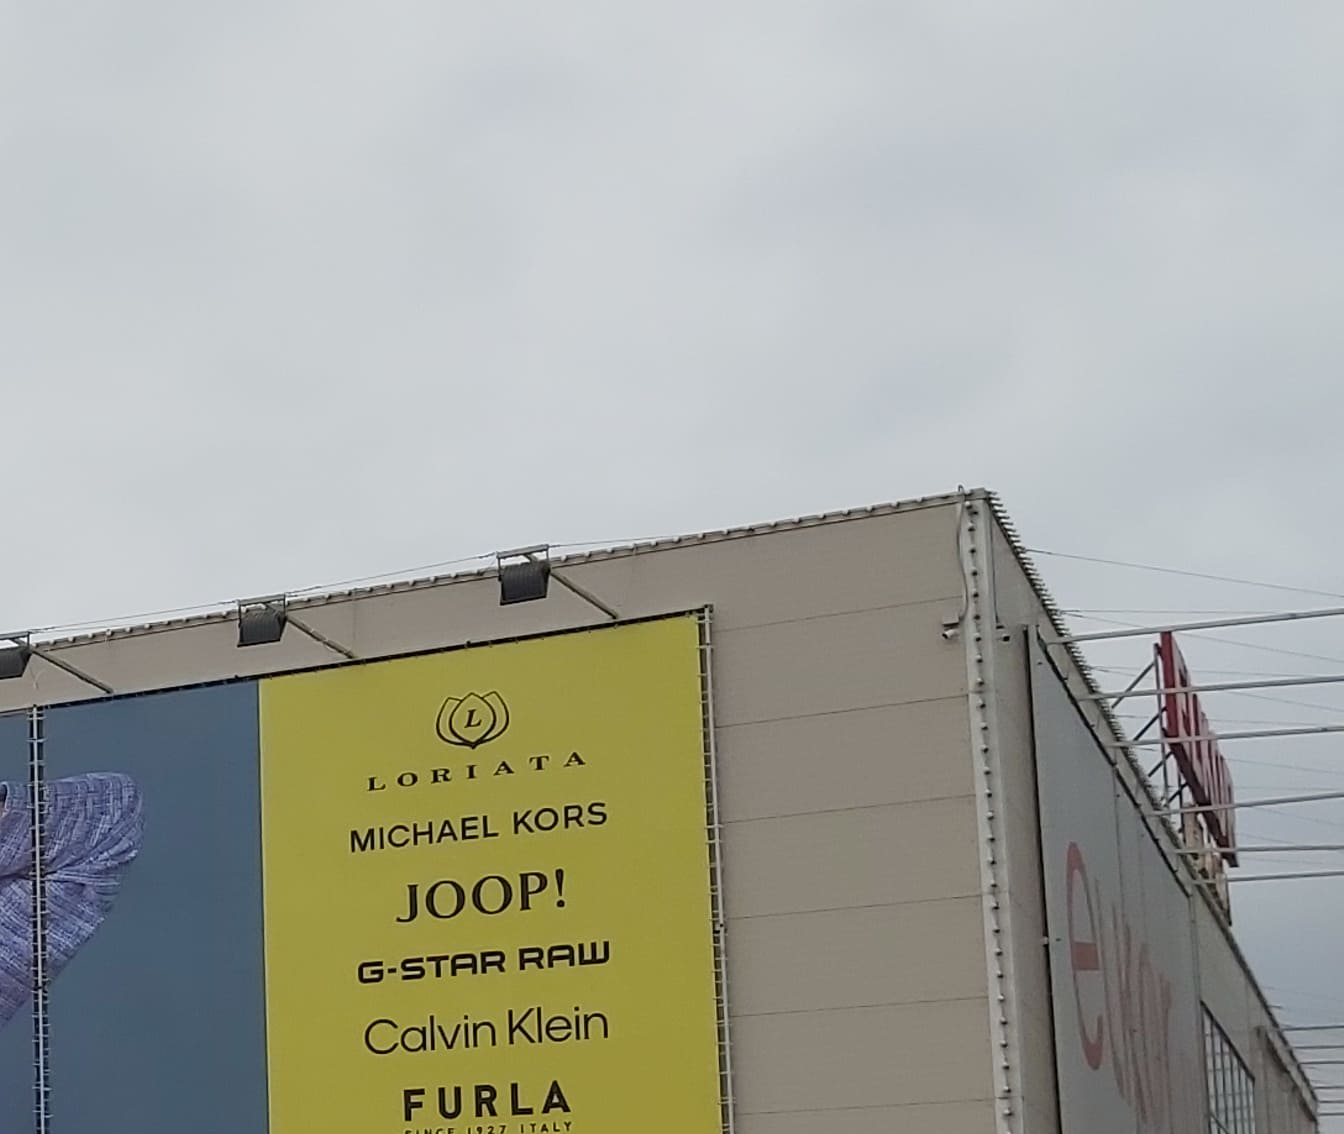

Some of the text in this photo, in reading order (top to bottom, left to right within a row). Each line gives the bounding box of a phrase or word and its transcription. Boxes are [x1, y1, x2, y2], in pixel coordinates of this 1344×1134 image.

[464, 708, 482, 728] L
[368, 751, 587, 792] LORIATA
[350, 803, 608, 854] MICHAEL KORS
[396, 868, 566, 923] JOOP!
[357, 941, 610, 985] G-STAR RAW
[364, 1005, 609, 1055] Calvin Klein
[403, 1080, 572, 1122] FURLA
[520, 1121, 572, 1134] ITALY
